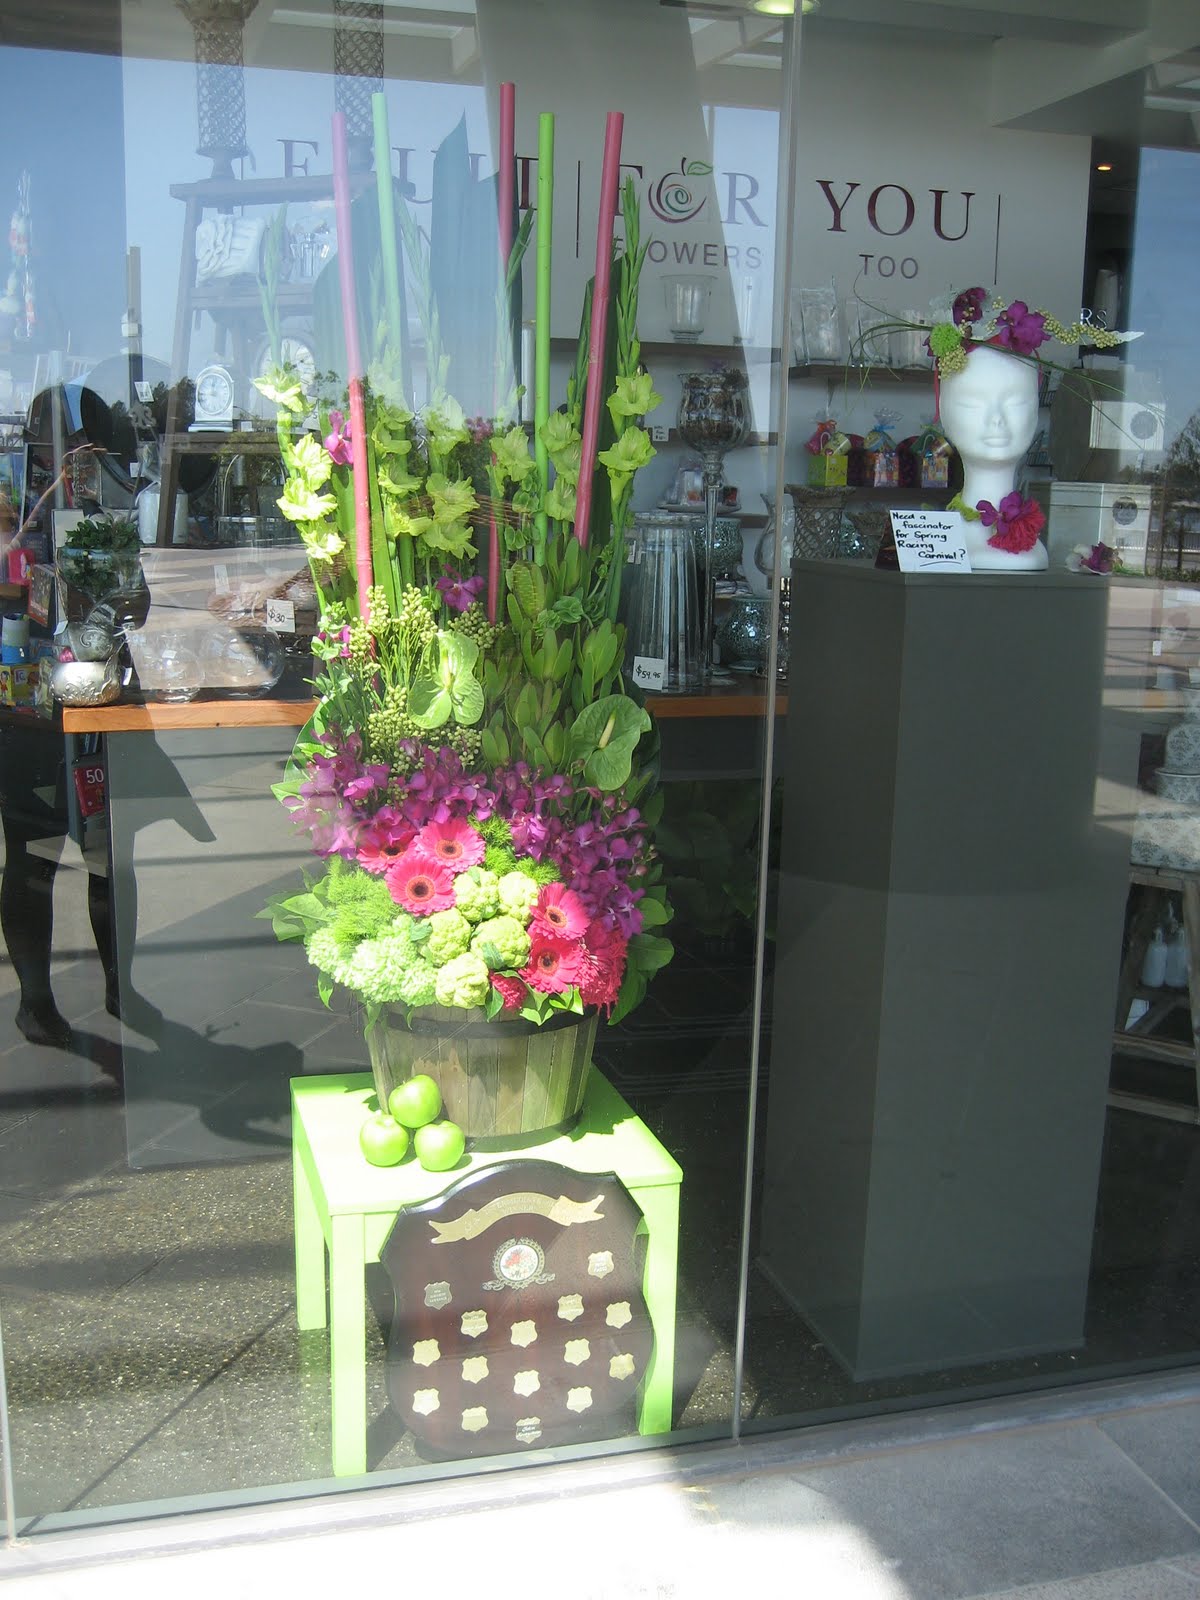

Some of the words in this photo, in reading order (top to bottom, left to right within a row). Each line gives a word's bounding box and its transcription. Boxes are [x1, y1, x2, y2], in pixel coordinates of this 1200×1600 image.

[815, 179, 976, 242] YOU
[613, 237, 762, 270] FOWERS
[858, 253, 920, 280] TOO
[892, 512, 915, 520] Need
[902, 520, 954, 531] fascinator
[895, 529, 910, 539] for
[914, 531, 947, 542] Spring
[897, 540, 935, 553] Racing
[86, 768, 104, 784] 50
